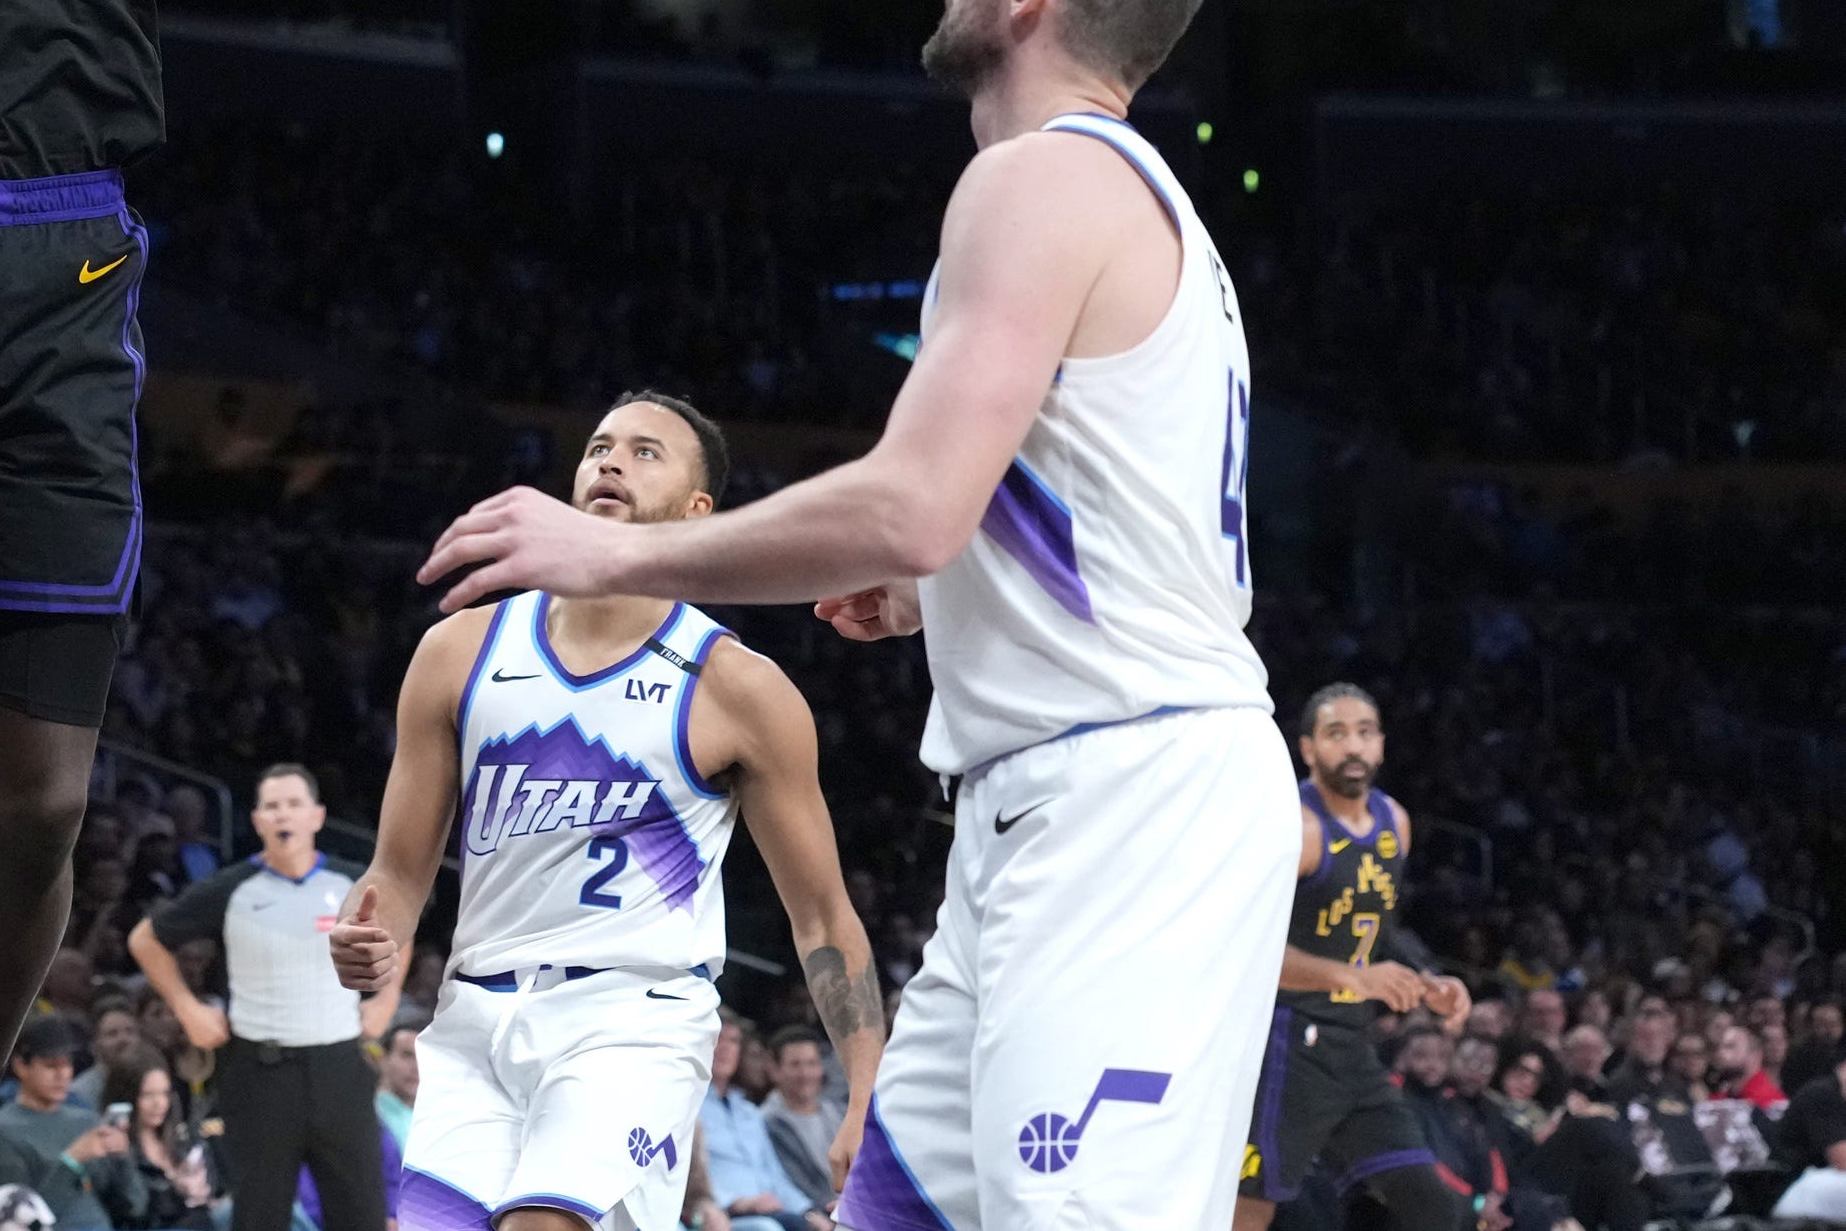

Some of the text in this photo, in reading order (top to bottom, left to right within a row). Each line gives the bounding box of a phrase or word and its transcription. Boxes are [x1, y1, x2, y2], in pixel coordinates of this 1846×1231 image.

[624, 678, 672, 704] LVT
[466, 763, 661, 856] UTAH
[579, 836, 629, 911] 2
[1315, 887, 1354, 937] LOS
[1348, 912, 1380, 970] 7
